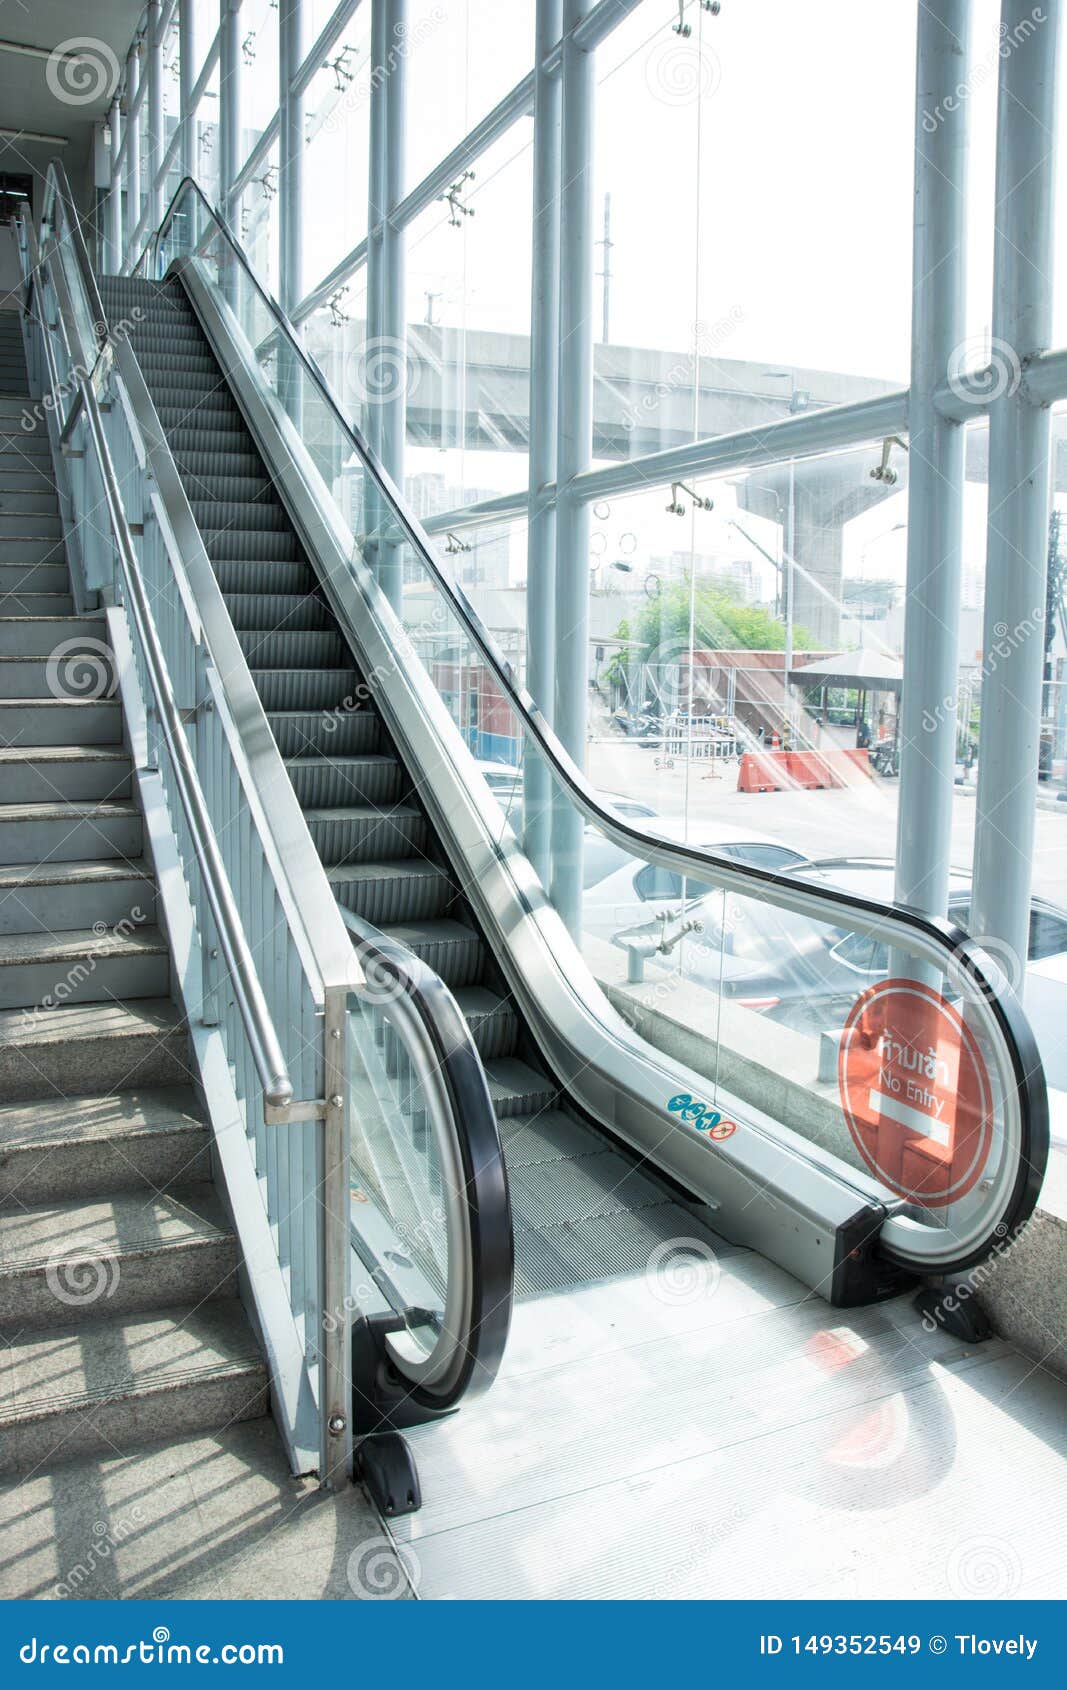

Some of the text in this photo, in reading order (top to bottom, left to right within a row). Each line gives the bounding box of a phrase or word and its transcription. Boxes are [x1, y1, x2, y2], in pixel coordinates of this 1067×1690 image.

[879, 1028, 949, 1087] ห้ามเข้า
[879, 1067, 945, 1119] No Entry
